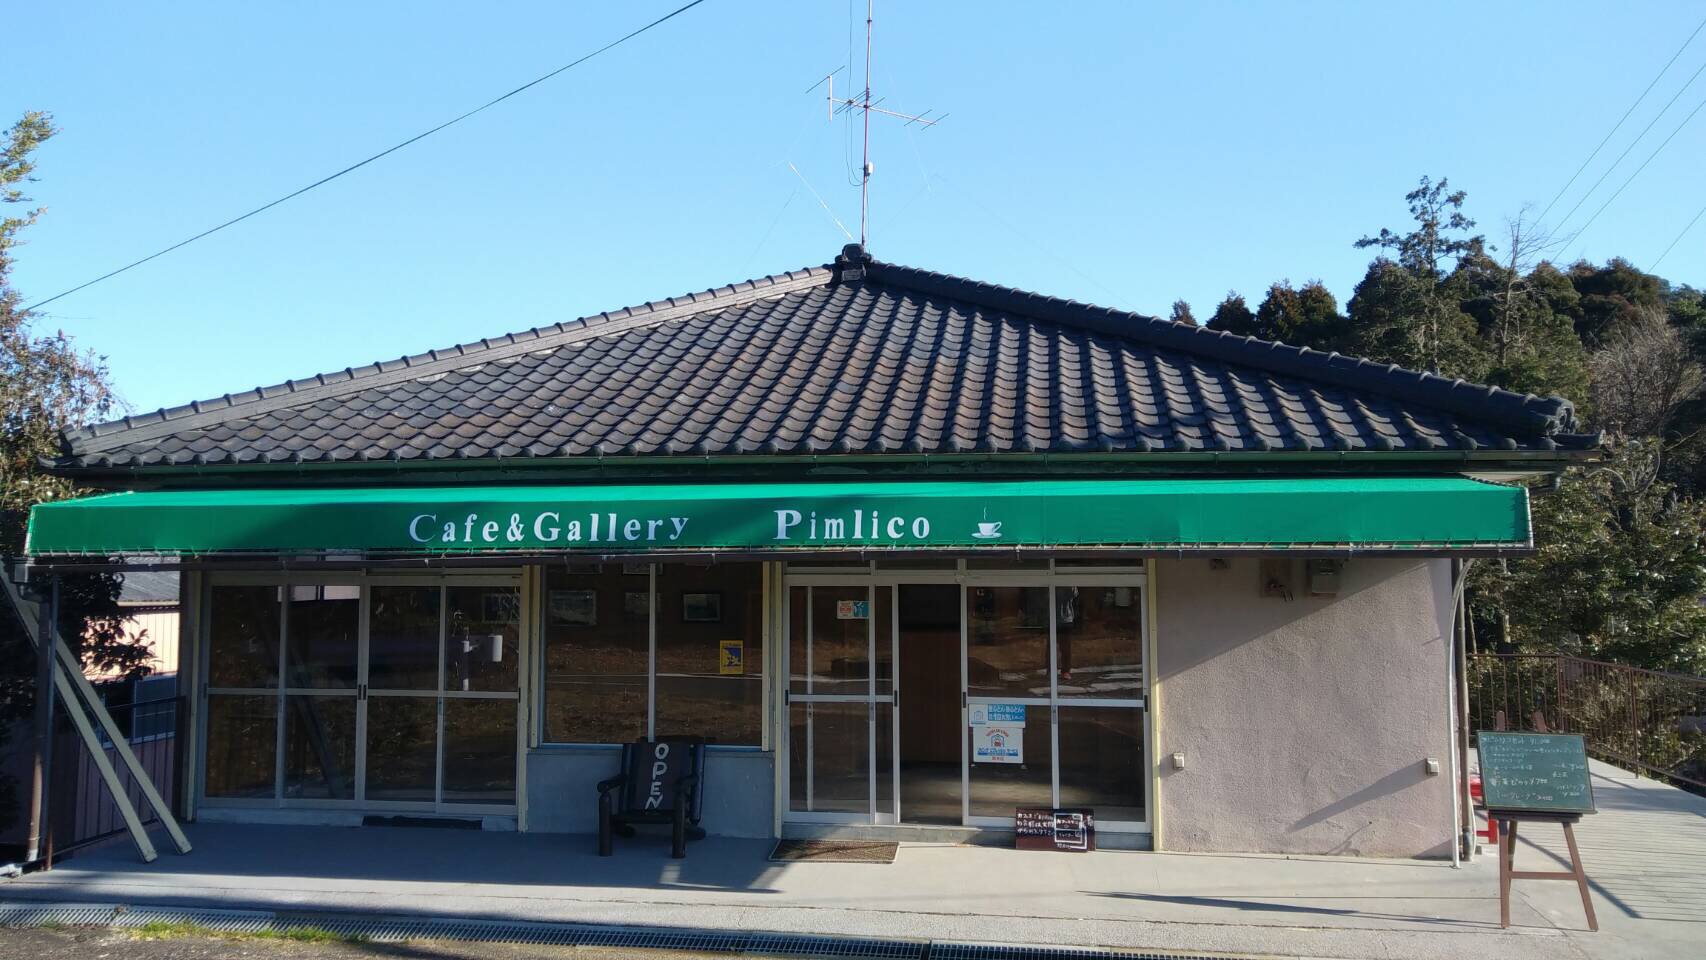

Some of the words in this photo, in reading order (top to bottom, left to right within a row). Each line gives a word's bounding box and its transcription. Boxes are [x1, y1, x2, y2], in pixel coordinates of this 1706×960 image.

[409, 511, 689, 543] Cafe&Gallery
[772, 509, 930, 540] Pimlico
[645, 743, 670, 810] OPEN
